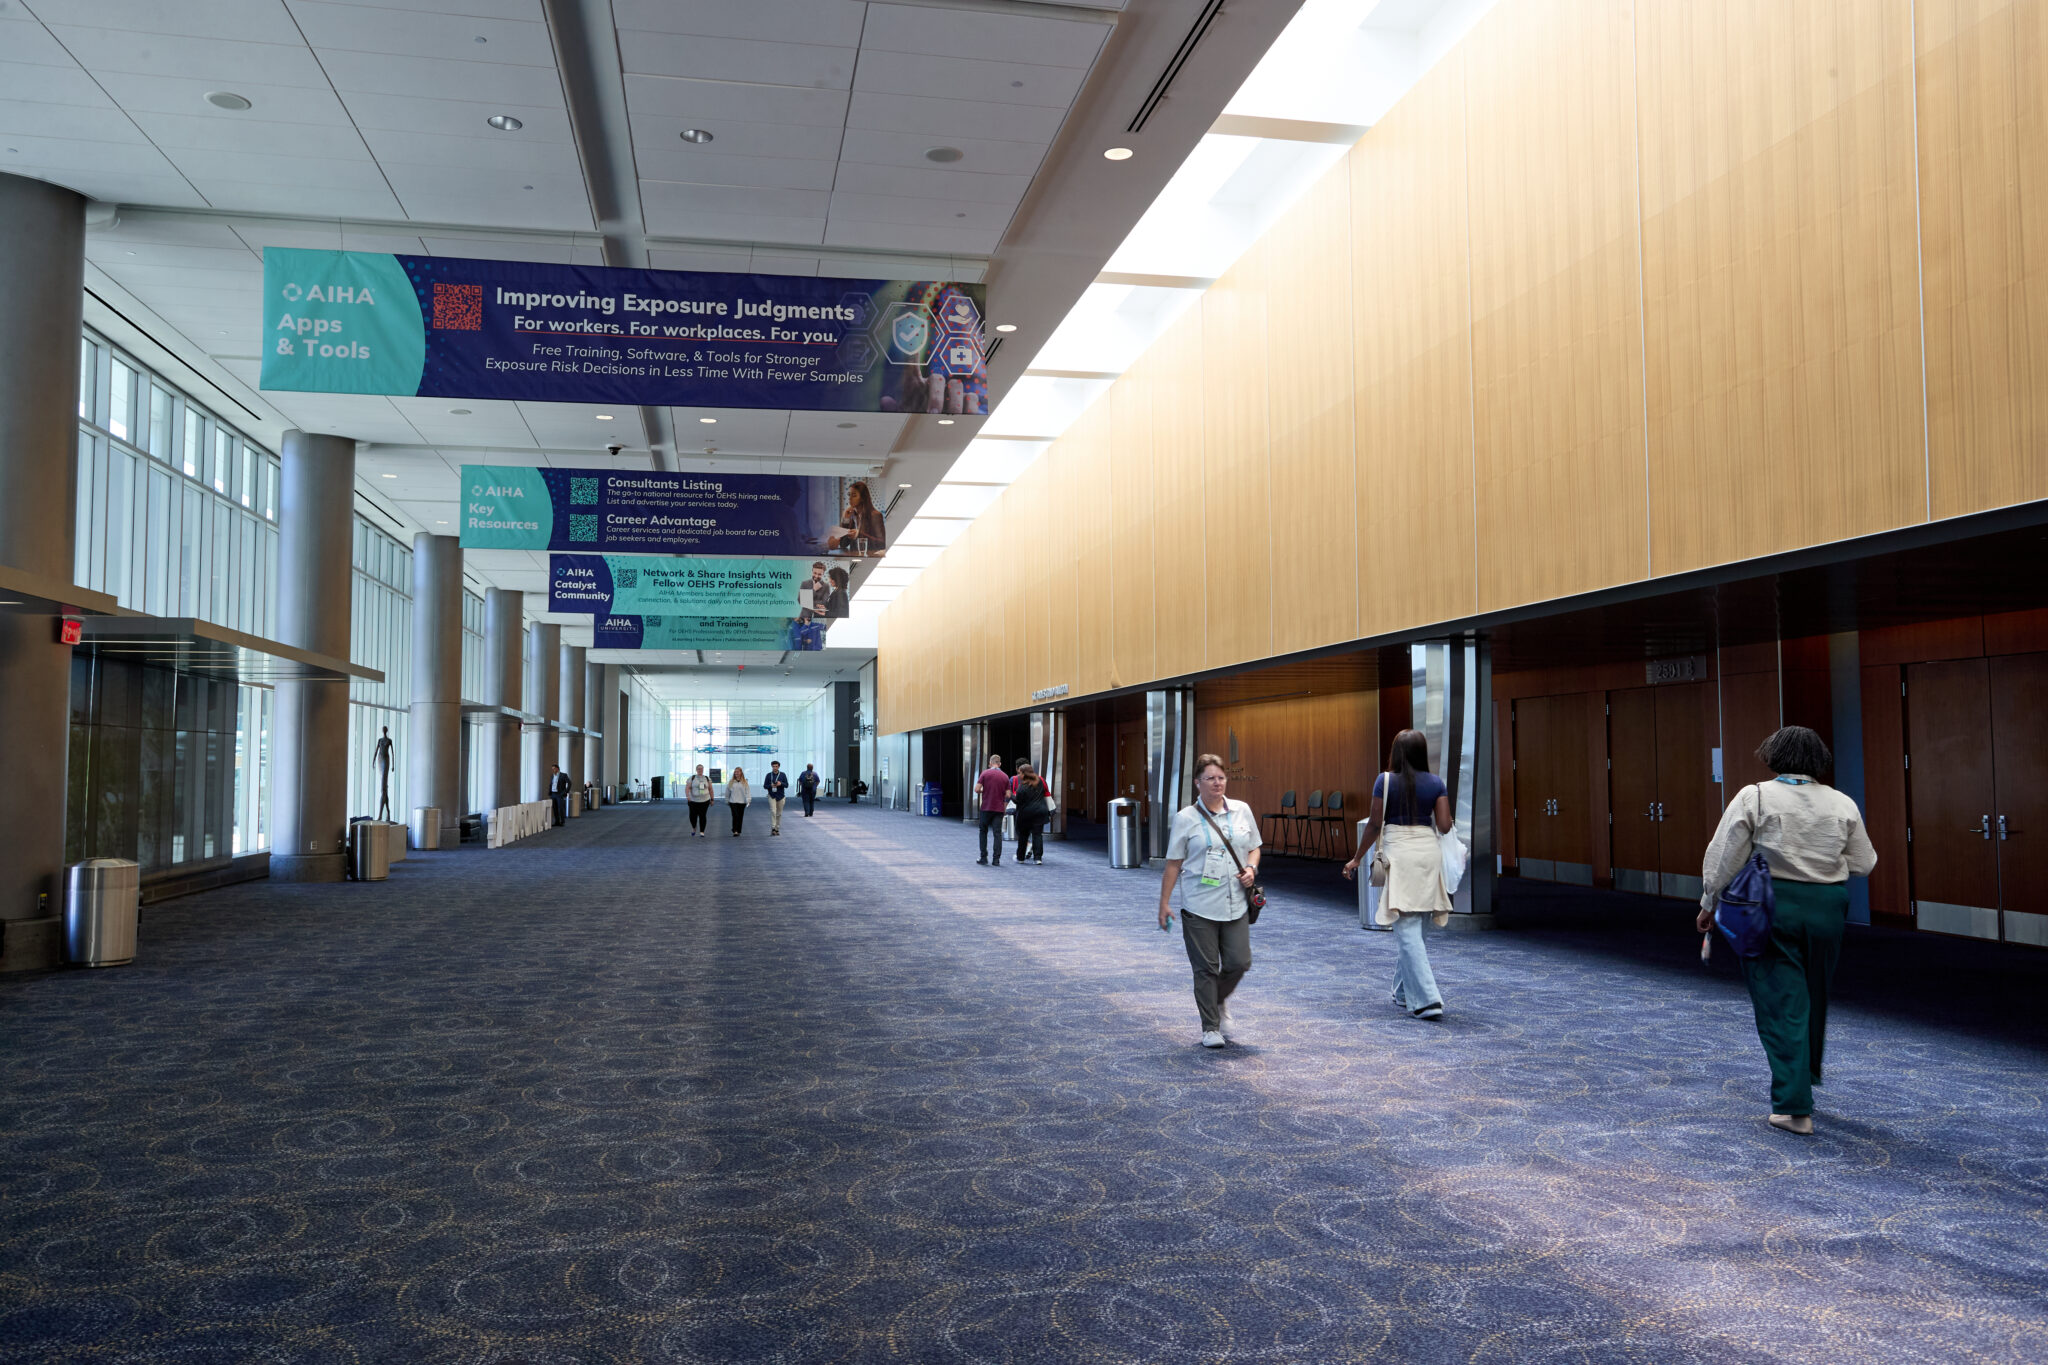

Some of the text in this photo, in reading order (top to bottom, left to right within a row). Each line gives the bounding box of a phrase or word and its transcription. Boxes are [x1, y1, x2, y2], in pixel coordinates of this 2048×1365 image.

[306, 284, 375, 305] AIHA
[496, 287, 855, 322] Improving Exposure Judgments
[276, 313, 343, 337] Apps
[514, 315, 838, 345] For workers. For workplaces. For you.
[276, 338, 370, 359] & Tools
[532, 343, 821, 368] Free Training, Software, & Tools for Stronger
[485, 357, 864, 384] Exposure Risk Decisions in Less Time With Fewer Samples
[607, 477, 723, 493] Consultants Listing
[485, 486, 524, 498] AIHA
[738, 493, 758, 501] hiring
[468, 503, 495, 516] Key
[468, 517, 539, 530] Resources
[606, 514, 717, 529] Career Advantage
[712, 529, 724, 537] job
[759, 529, 780, 537] OEHS
[662, 536, 701, 544] employers.
[566, 568, 594, 577] AIHA
[643, 569, 792, 580] Network & Share Insights With
[555, 580, 597, 590] Catalyst
[653, 579, 783, 589] Fellow OEHS Professionals
[555, 591, 610, 602] Community
[605, 619, 632, 627] AIHA
